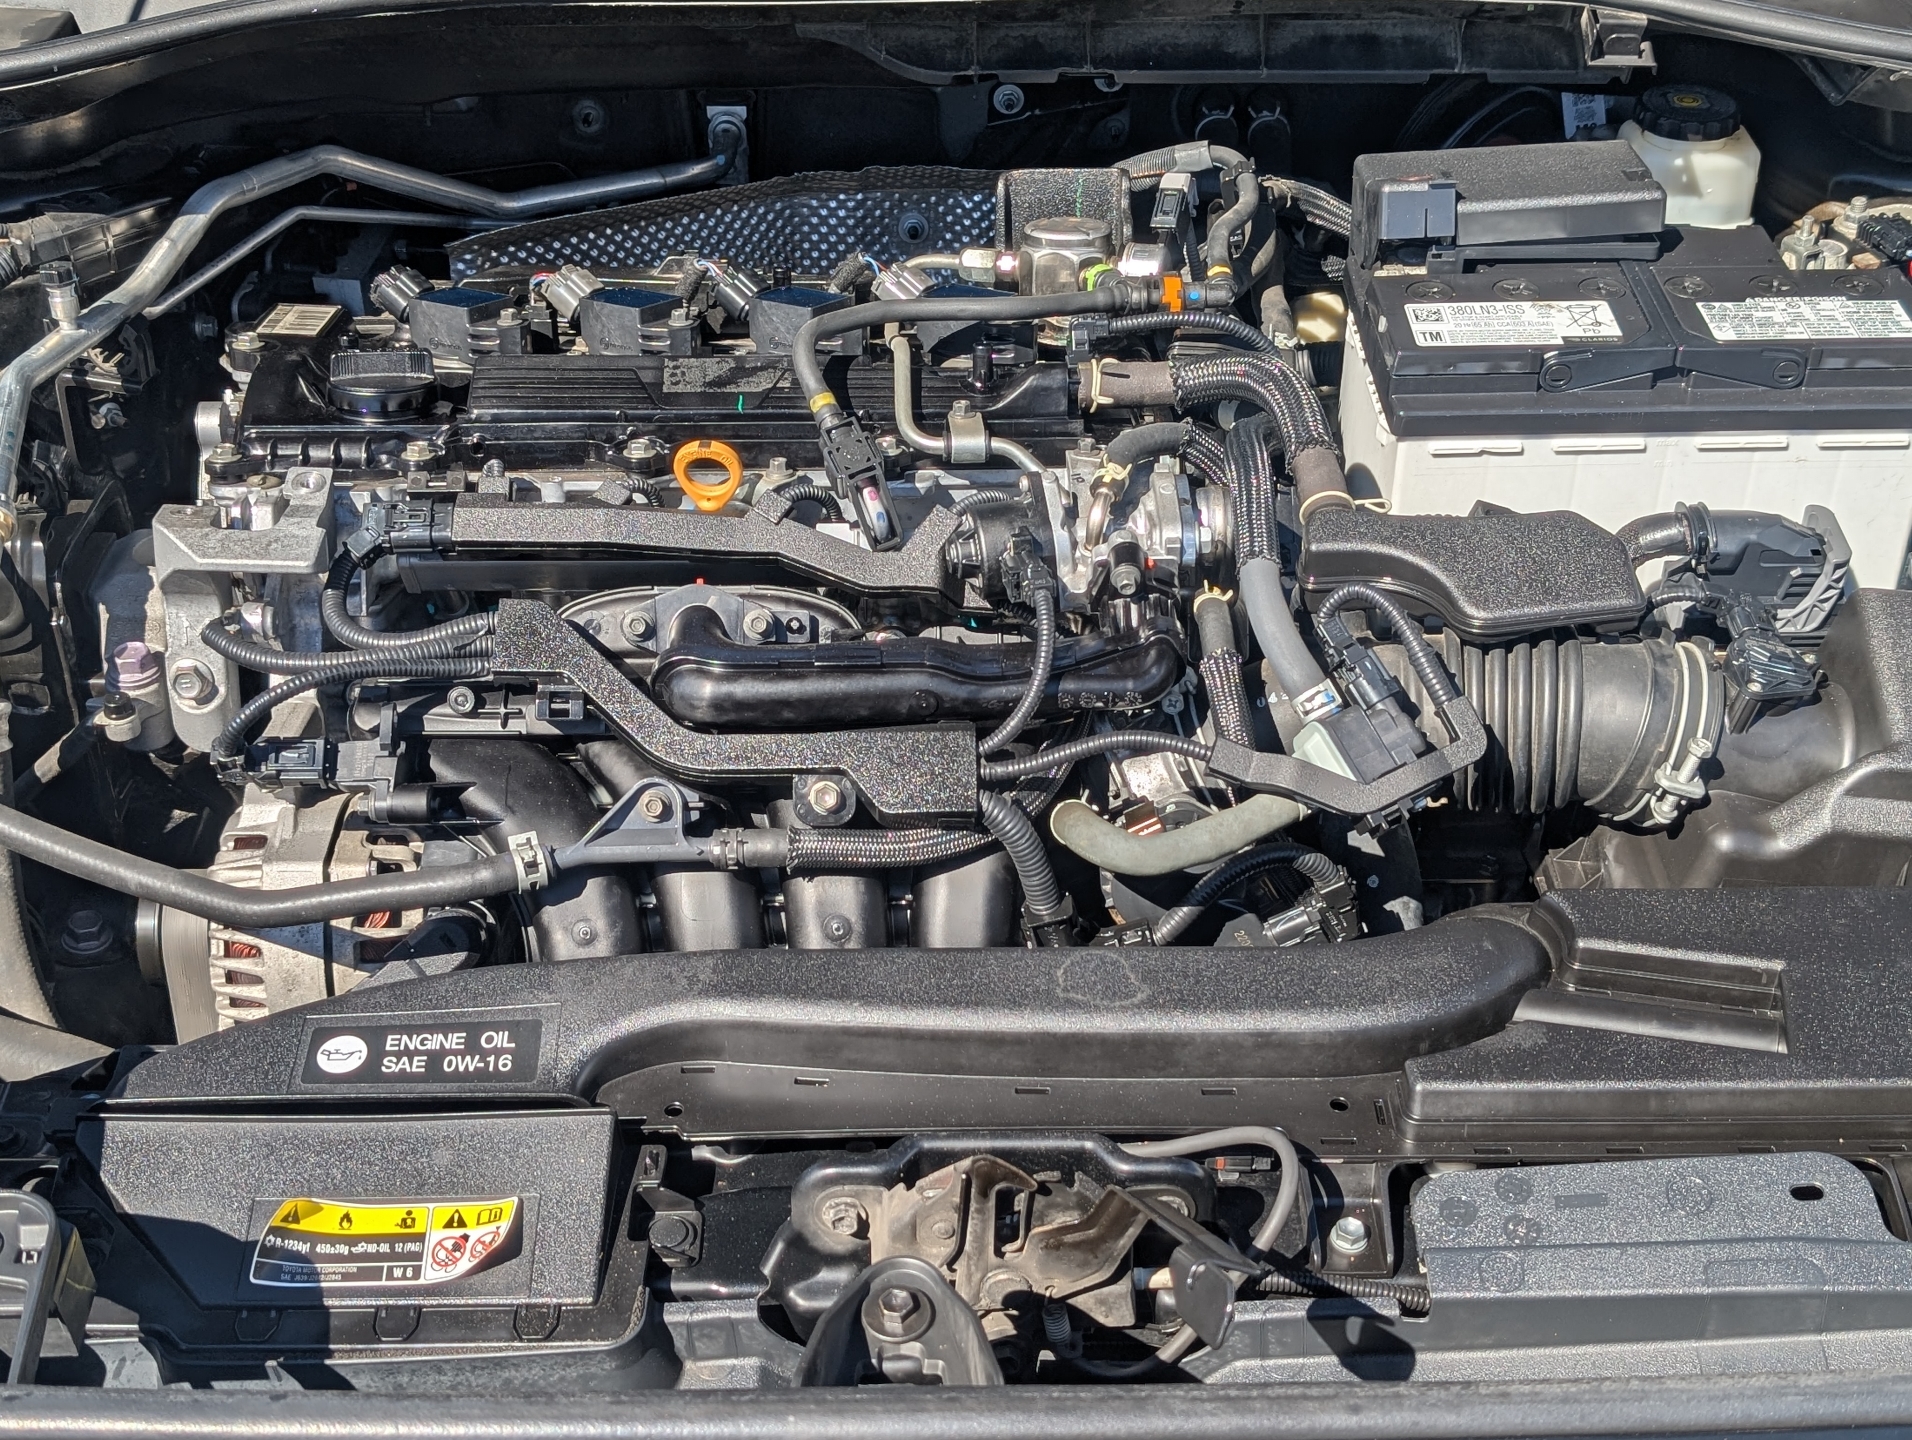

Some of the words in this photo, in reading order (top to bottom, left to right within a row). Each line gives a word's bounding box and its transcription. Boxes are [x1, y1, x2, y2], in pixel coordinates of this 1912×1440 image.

[1448, 304, 1526, 316] 380LN3-ISS
[1419, 331, 1444, 343] TM
[385, 1032, 467, 1051] ENGINE
[480, 1031, 516, 1049] OIL
[381, 1056, 428, 1073] SAE
[443, 1054, 513, 1072] 0W-16
[275, 1238, 310, 1254] R-1234yf
[315, 1243, 349, 1256] 450±30g
[366, 1242, 391, 1253] ND-OIL
[394, 1242, 403, 1253] 12
[404, 1241, 423, 1254] (PAG)
[282, 1264, 301, 1273] TOYOTA
[302, 1265, 320, 1273] MOTOR
[392, 1267, 404, 1278] W
[406, 1267, 413, 1278] 6
